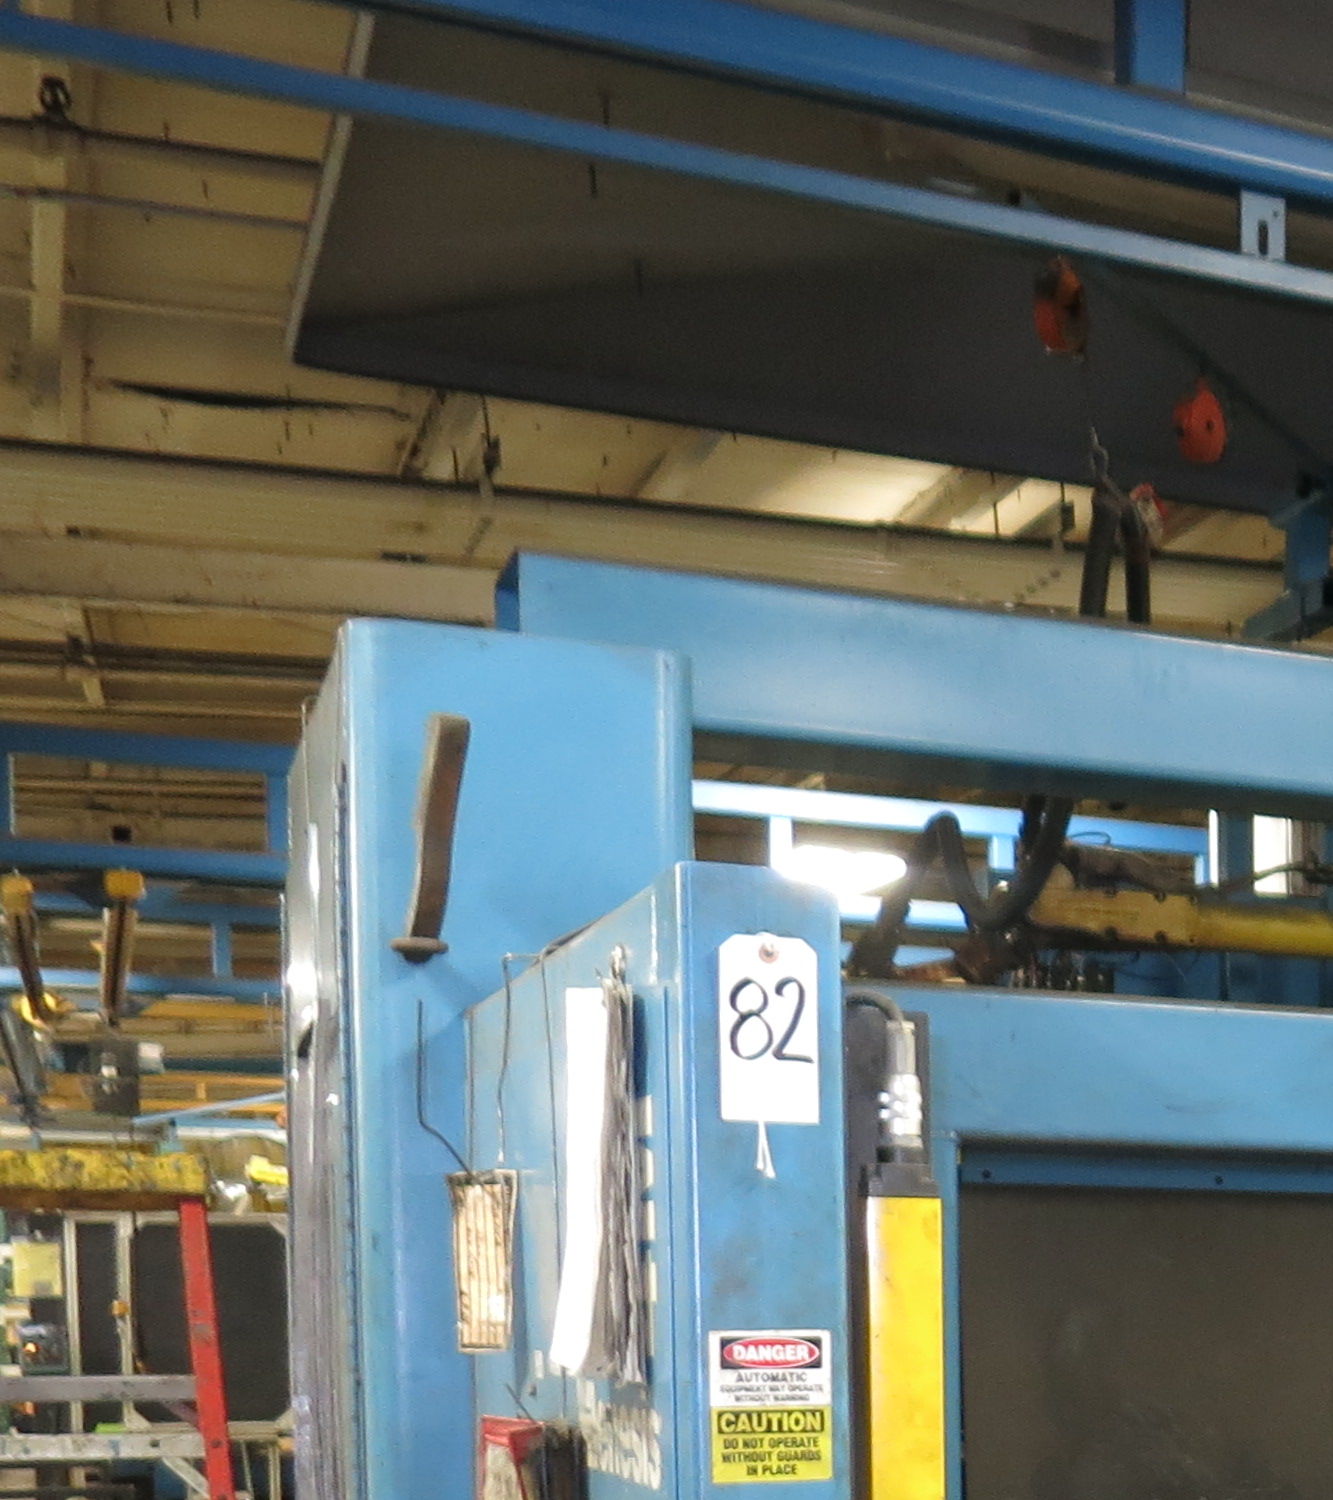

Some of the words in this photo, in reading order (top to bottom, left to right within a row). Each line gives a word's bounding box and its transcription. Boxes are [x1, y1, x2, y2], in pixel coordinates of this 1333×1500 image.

[727, 976, 815, 1064] 82
[733, 1343, 810, 1363] DANGER
[735, 1371, 808, 1383] AUTOMATIC
[719, 1411, 822, 1433] CAUTION
[723, 1438, 740, 1448] DO
[742, 1438, 764, 1448] NOT
[768, 1437, 819, 1448] OPERATE
[721, 1451, 773, 1462] WITHOUT
[776, 1450, 822, 1462] GUARDS
[746, 1465, 758, 1476] IN
[761, 1464, 797, 1476] PLACE
